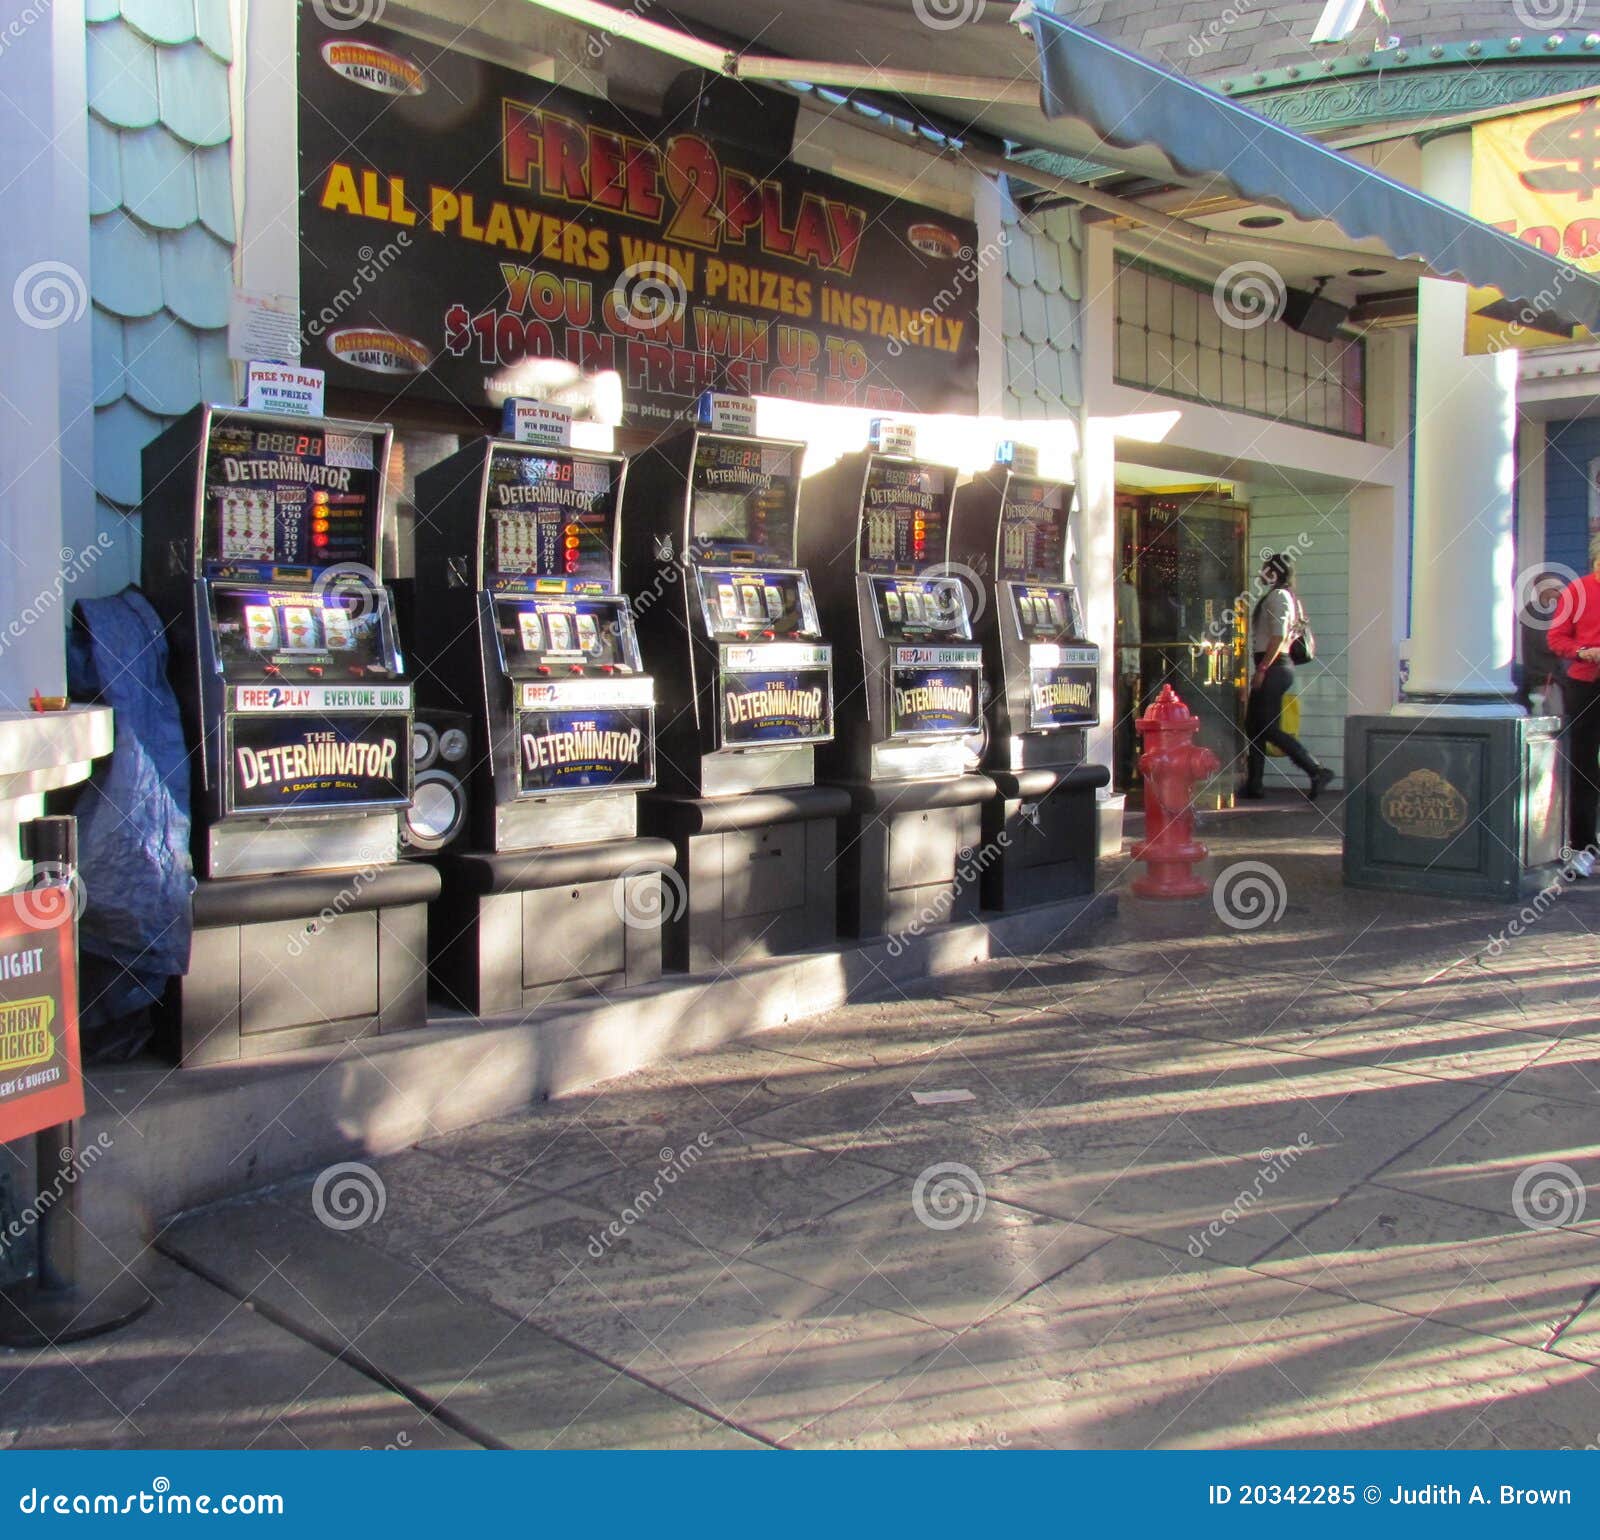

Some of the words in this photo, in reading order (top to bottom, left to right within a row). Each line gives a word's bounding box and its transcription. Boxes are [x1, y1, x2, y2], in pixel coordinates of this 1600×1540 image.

[353, 66, 376, 82] GAME
[502, 97, 664, 224] FREE
[663, 133, 721, 251] 2
[723, 167, 867, 276] PLAY
[320, 161, 417, 227] ALL
[430, 185, 609, 271] PLAYERS
[620, 235, 695, 292] WIN
[707, 258, 814, 319] PRIZES
[821, 286, 964, 353] INSTANTLY
[499, 263, 592, 328] YOU
[602, 289, 685, 348] CAN
[692, 307, 768, 363] WIN
[777, 325, 820, 370] UP
[825, 336, 867, 381] TO
[357, 352, 381, 365] GAME
[445, 304, 554, 368] $100
[565, 327, 615, 375] IN
[626, 339, 717, 398] FREE
[251, 371, 278, 381] FREE
[280, 372, 294, 382] TO
[297, 375, 323, 388] PLAY
[261, 387, 278, 396] WIN
[281, 389, 312, 400] PRIZES
[517, 407, 537, 417] FREE
[539, 408, 550, 418] TO
[552, 411, 571, 422] PLAY
[641, 402, 672, 418] prizes
[224, 458, 351, 491] DETERMINATOR
[500, 484, 593, 511] DETERMINATOR
[1150, 506, 1170, 523] Play
[546, 685, 559, 701] 2
[765, 681, 785, 690] THE
[927, 679, 944, 687] THE
[243, 690, 269, 706] FREE
[268, 688, 287, 708] 2
[285, 690, 310, 706] PLAY
[324, 690, 376, 706] EVERYONE
[380, 690, 404, 706] WINS
[726, 687, 822, 725] DETERMINATOR
[896, 684, 973, 717] DETERMINATOR
[572, 721, 595, 731] THE
[304, 731, 336, 743] THE
[523, 727, 641, 770] DETERMINATOR
[236, 738, 397, 790] DETERMINATOR
[0, 1005, 41, 1034] SHOW
[26, 1066, 60, 1088] BUFFETS
